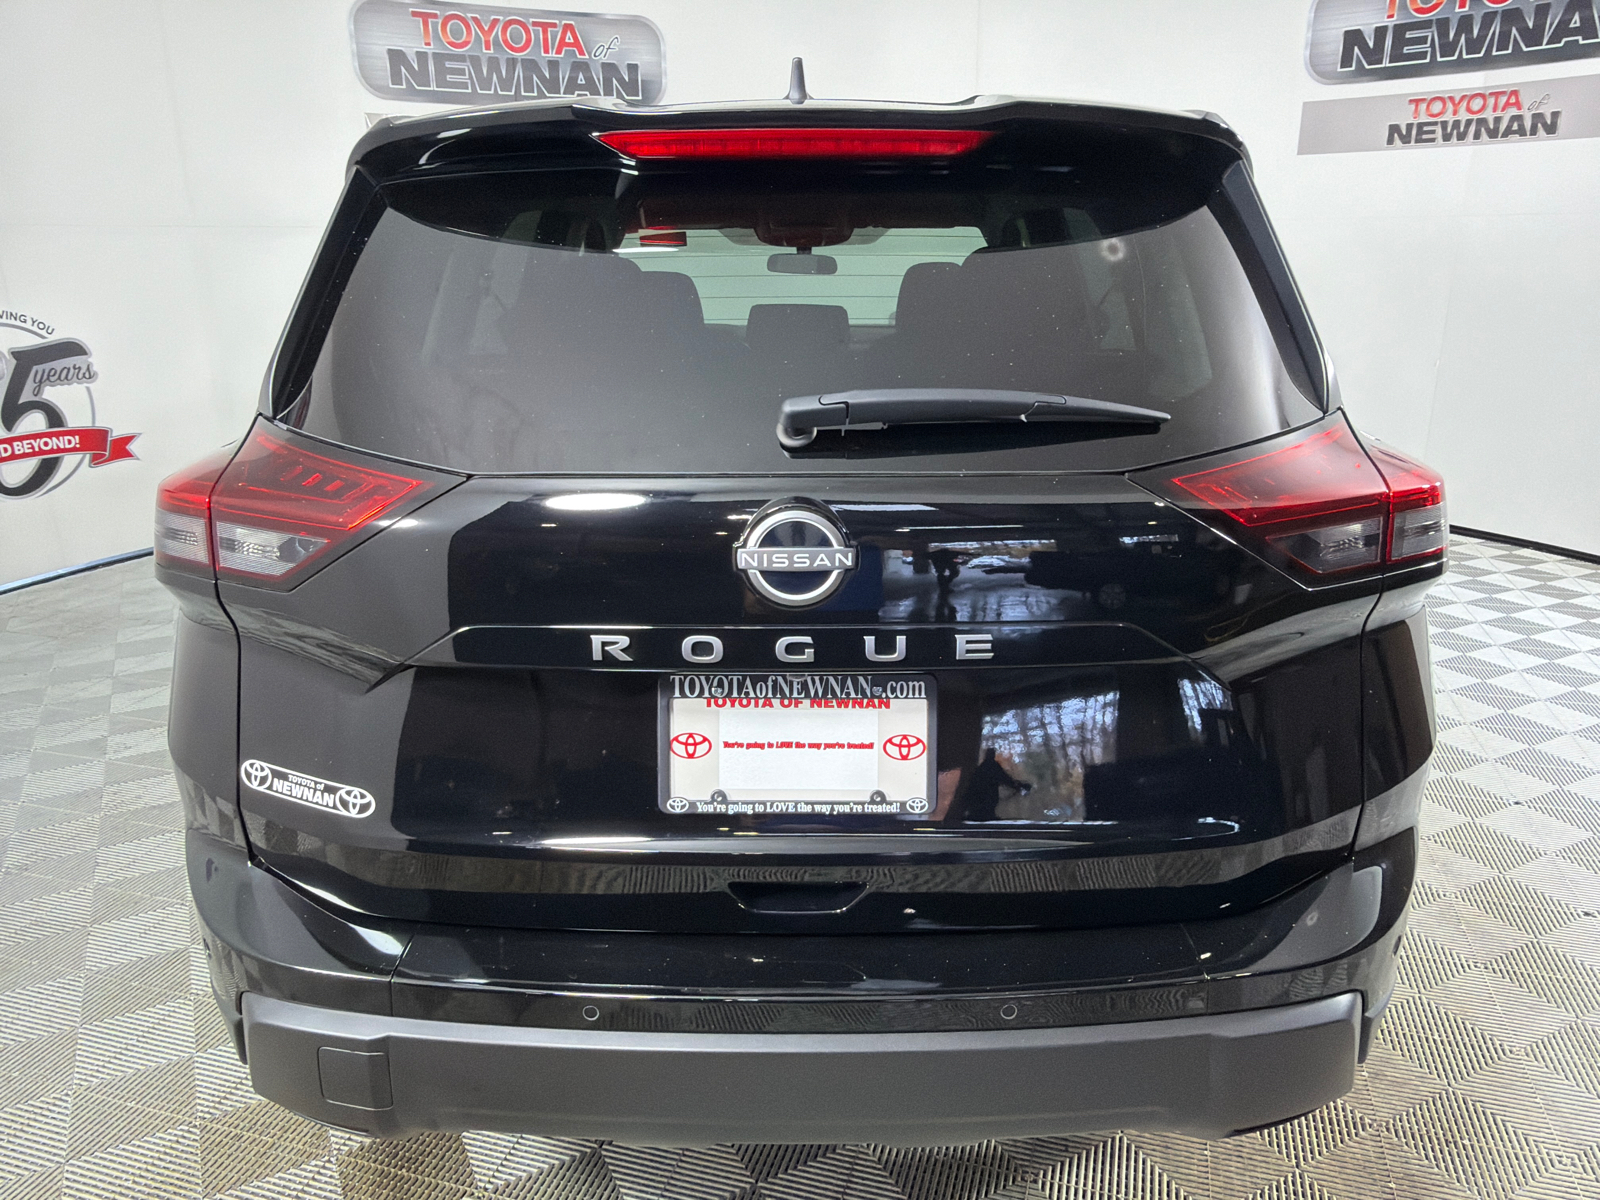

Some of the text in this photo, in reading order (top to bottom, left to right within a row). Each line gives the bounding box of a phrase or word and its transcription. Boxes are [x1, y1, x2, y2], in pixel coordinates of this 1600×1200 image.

[409, 9, 620, 59] TOYOTA of
[1337, 0, 1600, 71] NEWNA
[386, 48, 643, 99] NEWNAN
[1408, 89, 1550, 119] TOYOTA of
[1385, 110, 1561, 146] NEWNAN
[30, 317, 55, 335] YOU
[33, 362, 96, 397] years
[12, 435, 80, 455] BEYOND!
[740, 552, 854, 568] NISSAN
[590, 634, 994, 663] ROGUE
[810, 698, 890, 709] NEWNAN
[272, 778, 334, 807] NEWNAN
[288, 775, 315, 788] TOYOTA
[696, 802, 900, 815] You're going to LOVE the way you're treated!
